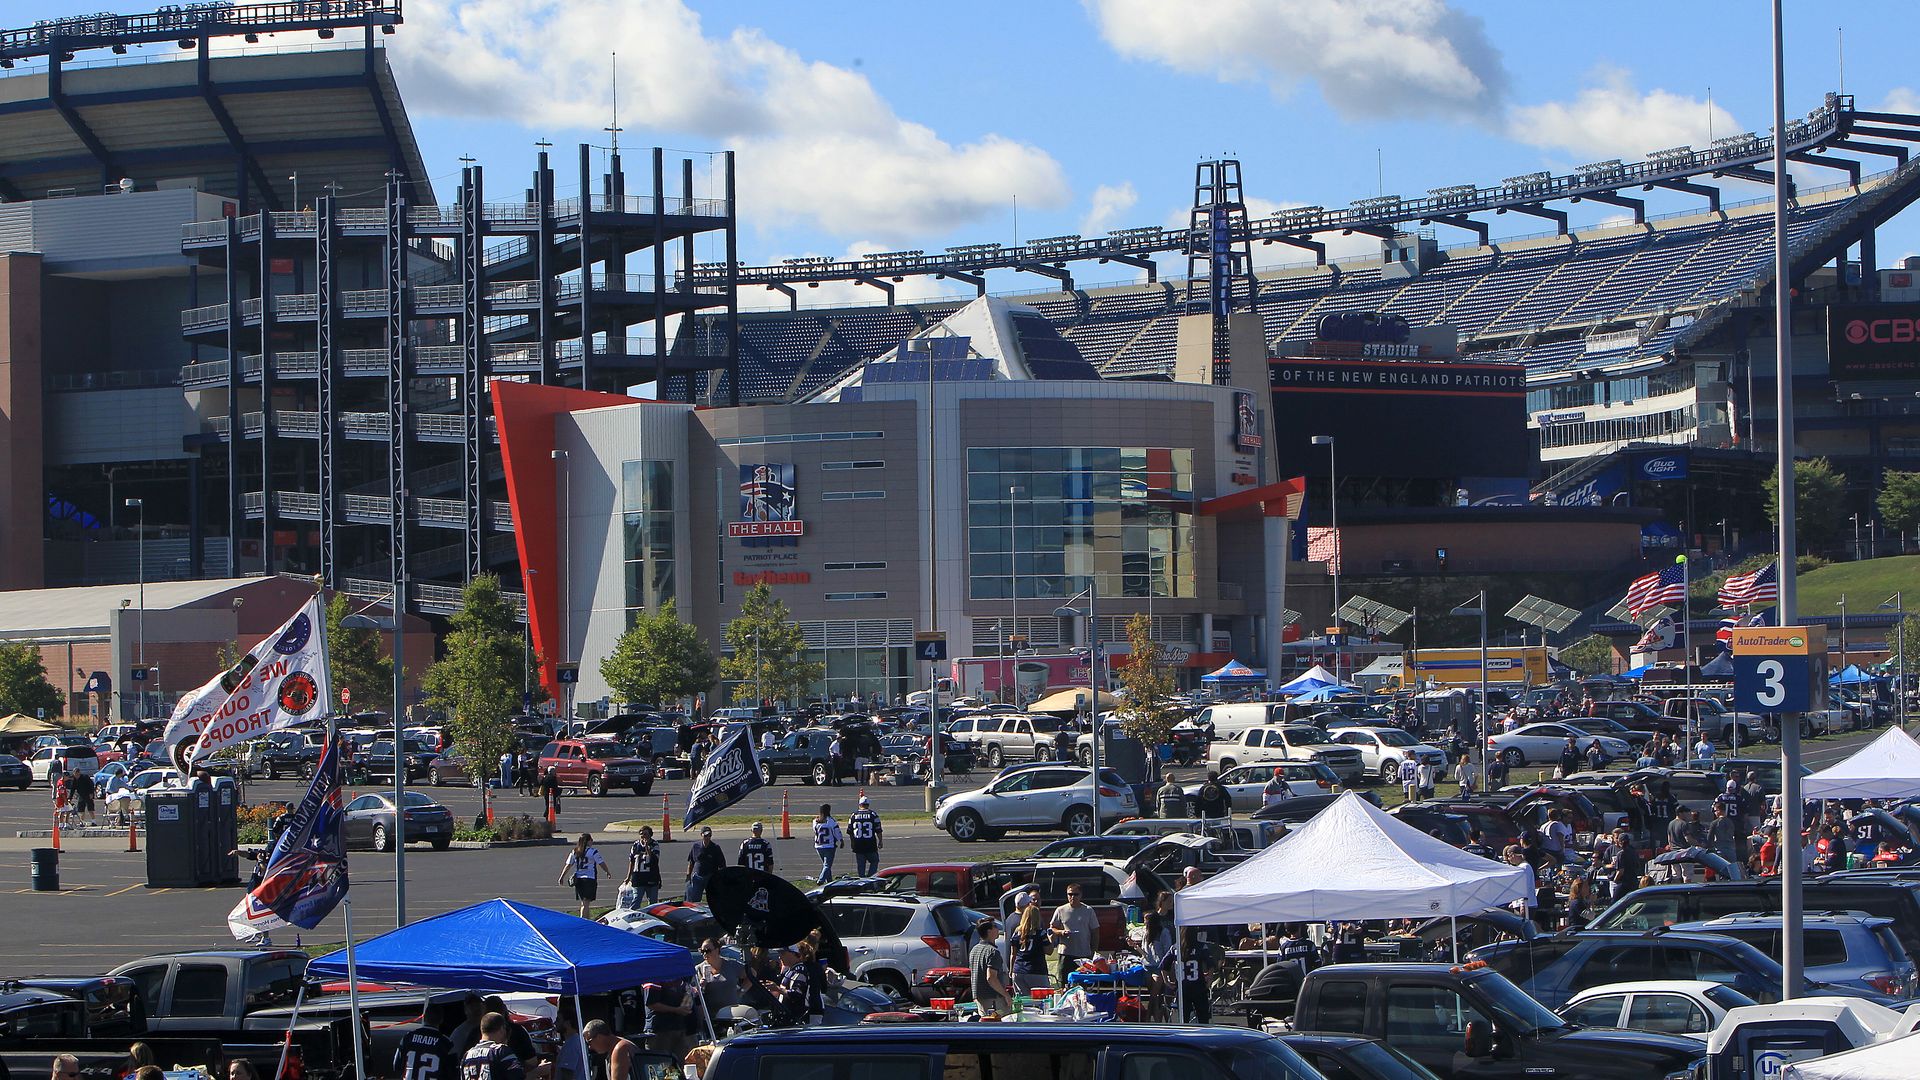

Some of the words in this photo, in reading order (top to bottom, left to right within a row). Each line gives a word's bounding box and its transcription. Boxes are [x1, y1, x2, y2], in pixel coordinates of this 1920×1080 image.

[1363, 344, 1419, 357] STADIUM
[1283, 369, 1302, 381] OF
[1307, 370, 1335, 382] THE
[1342, 371, 1373, 383] NEW
[1379, 373, 1449, 385] ENGLAND
[1455, 375, 1526, 387] PATRIOTS
[1560, 479, 1598, 506] IGHT
[731, 524, 759, 534] THE
[763, 522, 801, 533] HALL
[1016, 641, 1023, 650] 4
[1330, 635, 1337, 646] 4
[1736, 635, 1790, 646] AutoTrader
[924, 642, 938, 658] 4
[1296, 655, 1323, 663] verion
[135, 670, 143, 680] 4
[563, 670, 573, 681] 4
[1756, 660, 1785, 707] 3
[1402, 768, 1415, 780] 12
[1656, 805, 1668, 818] 11
[853, 821, 873, 839] 83
[633, 854, 650, 872] 12
[746, 852, 765, 871] 12
[411, 1034, 439, 1046] BRADY
[404, 1050, 440, 1080] 12
